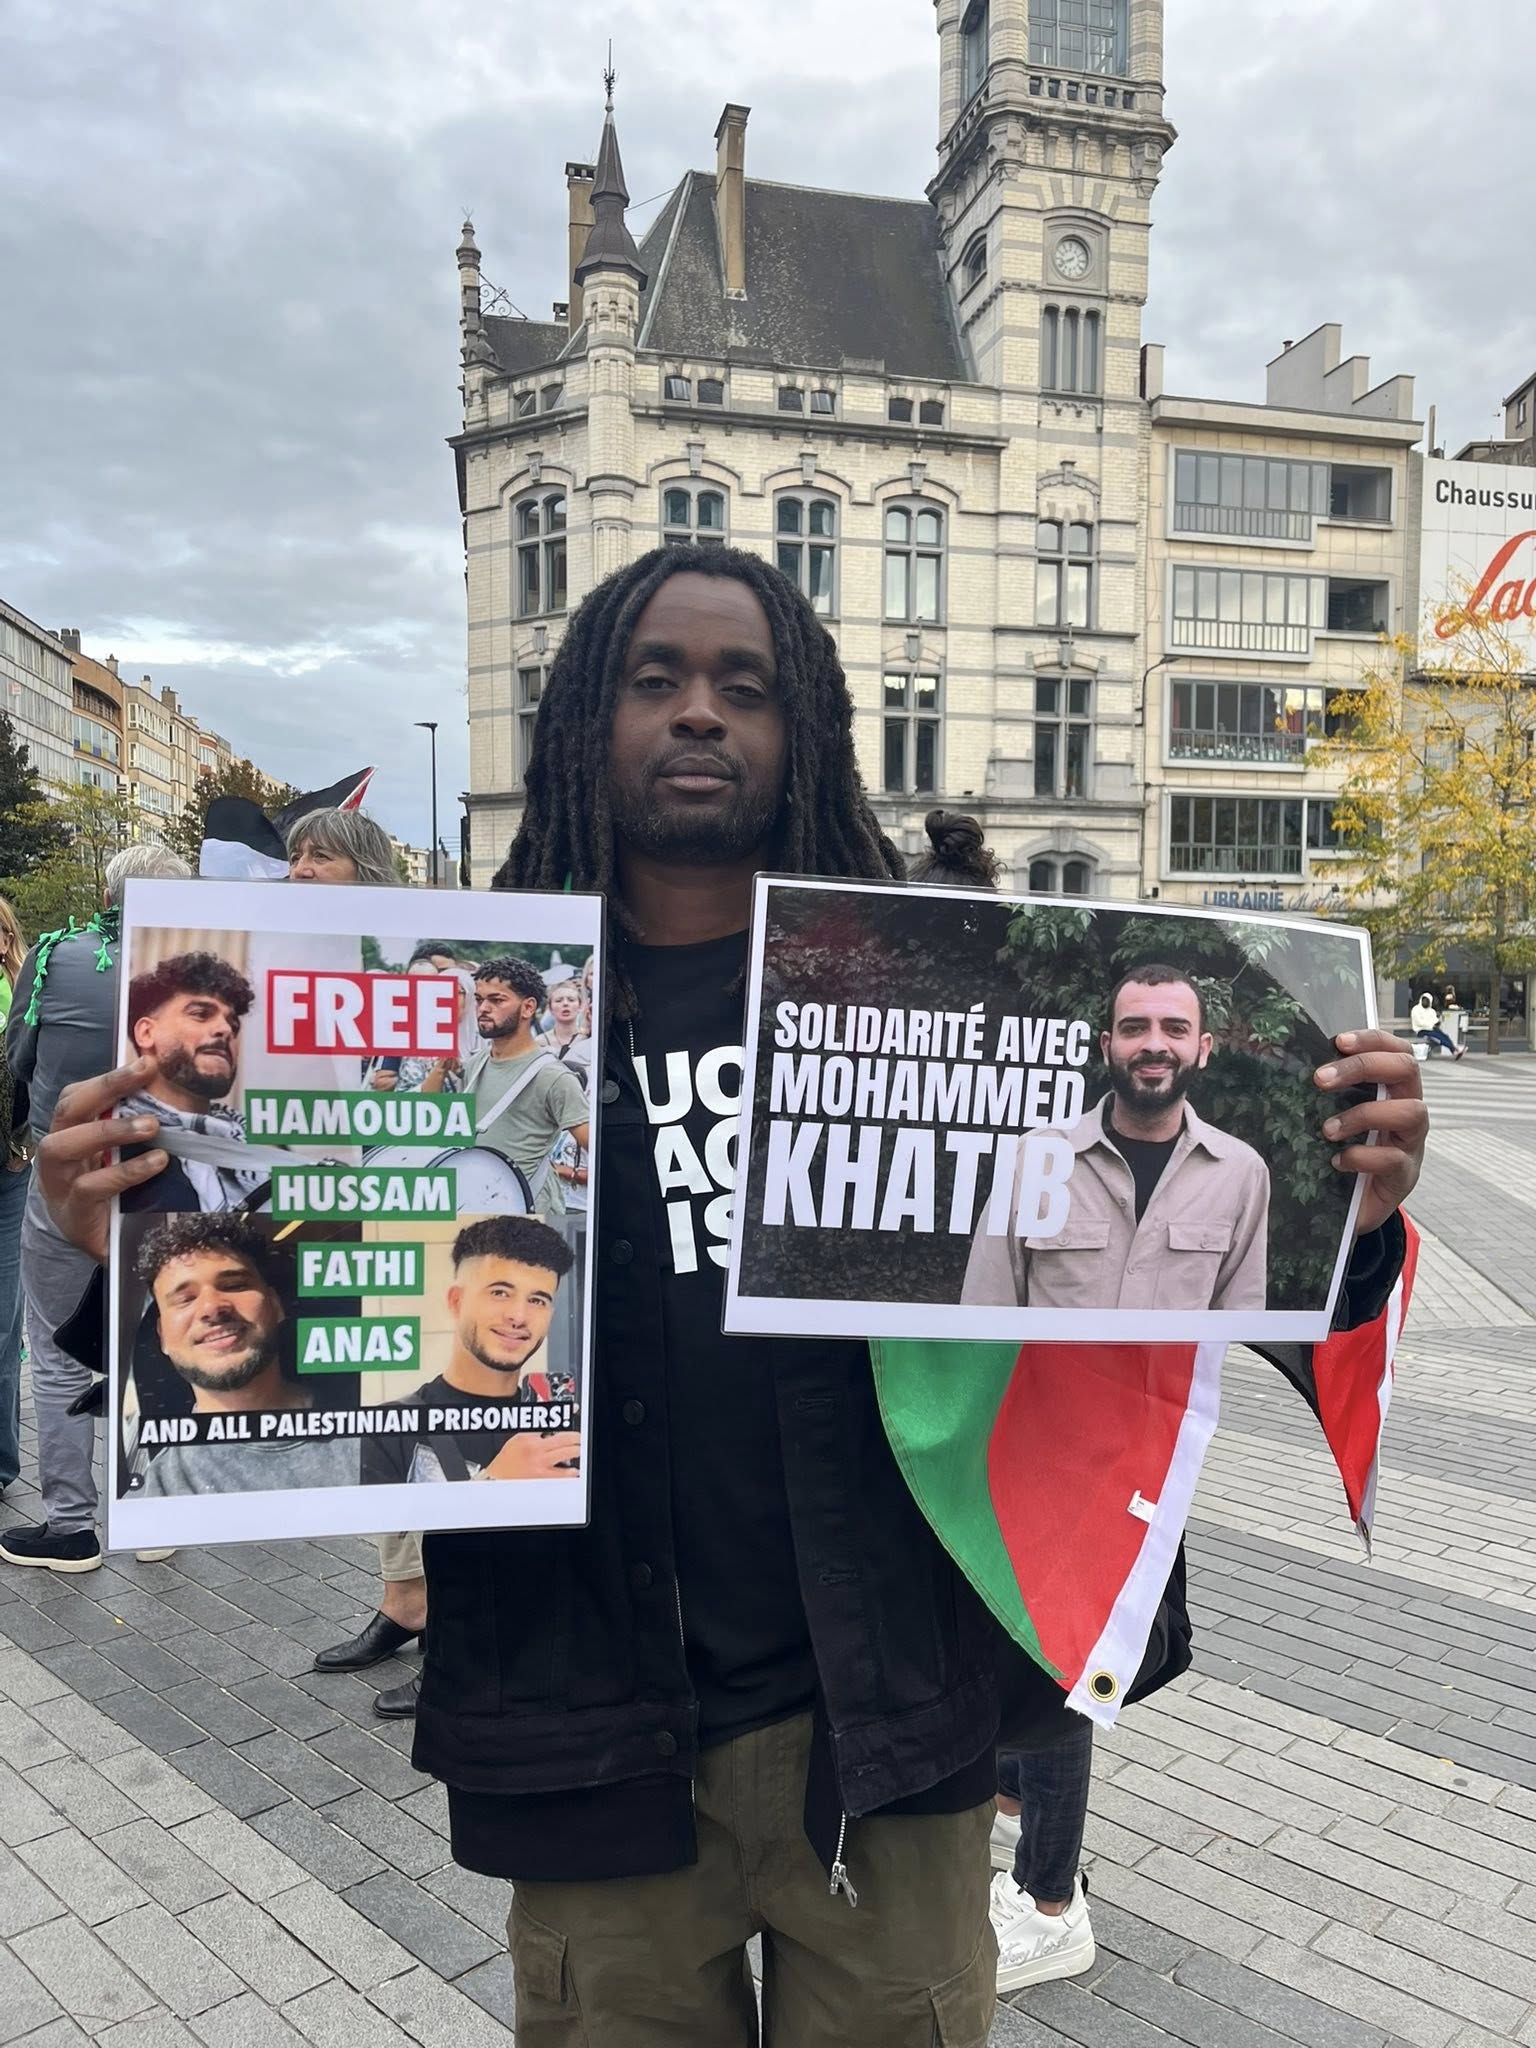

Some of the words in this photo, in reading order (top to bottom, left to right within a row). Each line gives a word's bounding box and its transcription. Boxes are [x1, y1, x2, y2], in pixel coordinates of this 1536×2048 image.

[273, 975, 454, 1050] FREE
[774, 1001, 986, 1060] SOLIDARITÉ
[995, 1015, 1091, 1066] AVEC
[769, 1052, 1086, 1130] MOHAMMED
[250, 1098, 473, 1138] HAMOUDA
[278, 1175, 451, 1212] HUSSAM
[762, 1120, 1076, 1239] KHATIB
[303, 1250, 416, 1287] FATHI
[303, 1325, 414, 1364] ANAS
[139, 1418, 198, 1444] AND
[206, 1415, 252, 1441] ALL
[259, 1408, 419, 1438] PALESTINIAN
[428, 1404, 571, 1431] PRISONERS!
